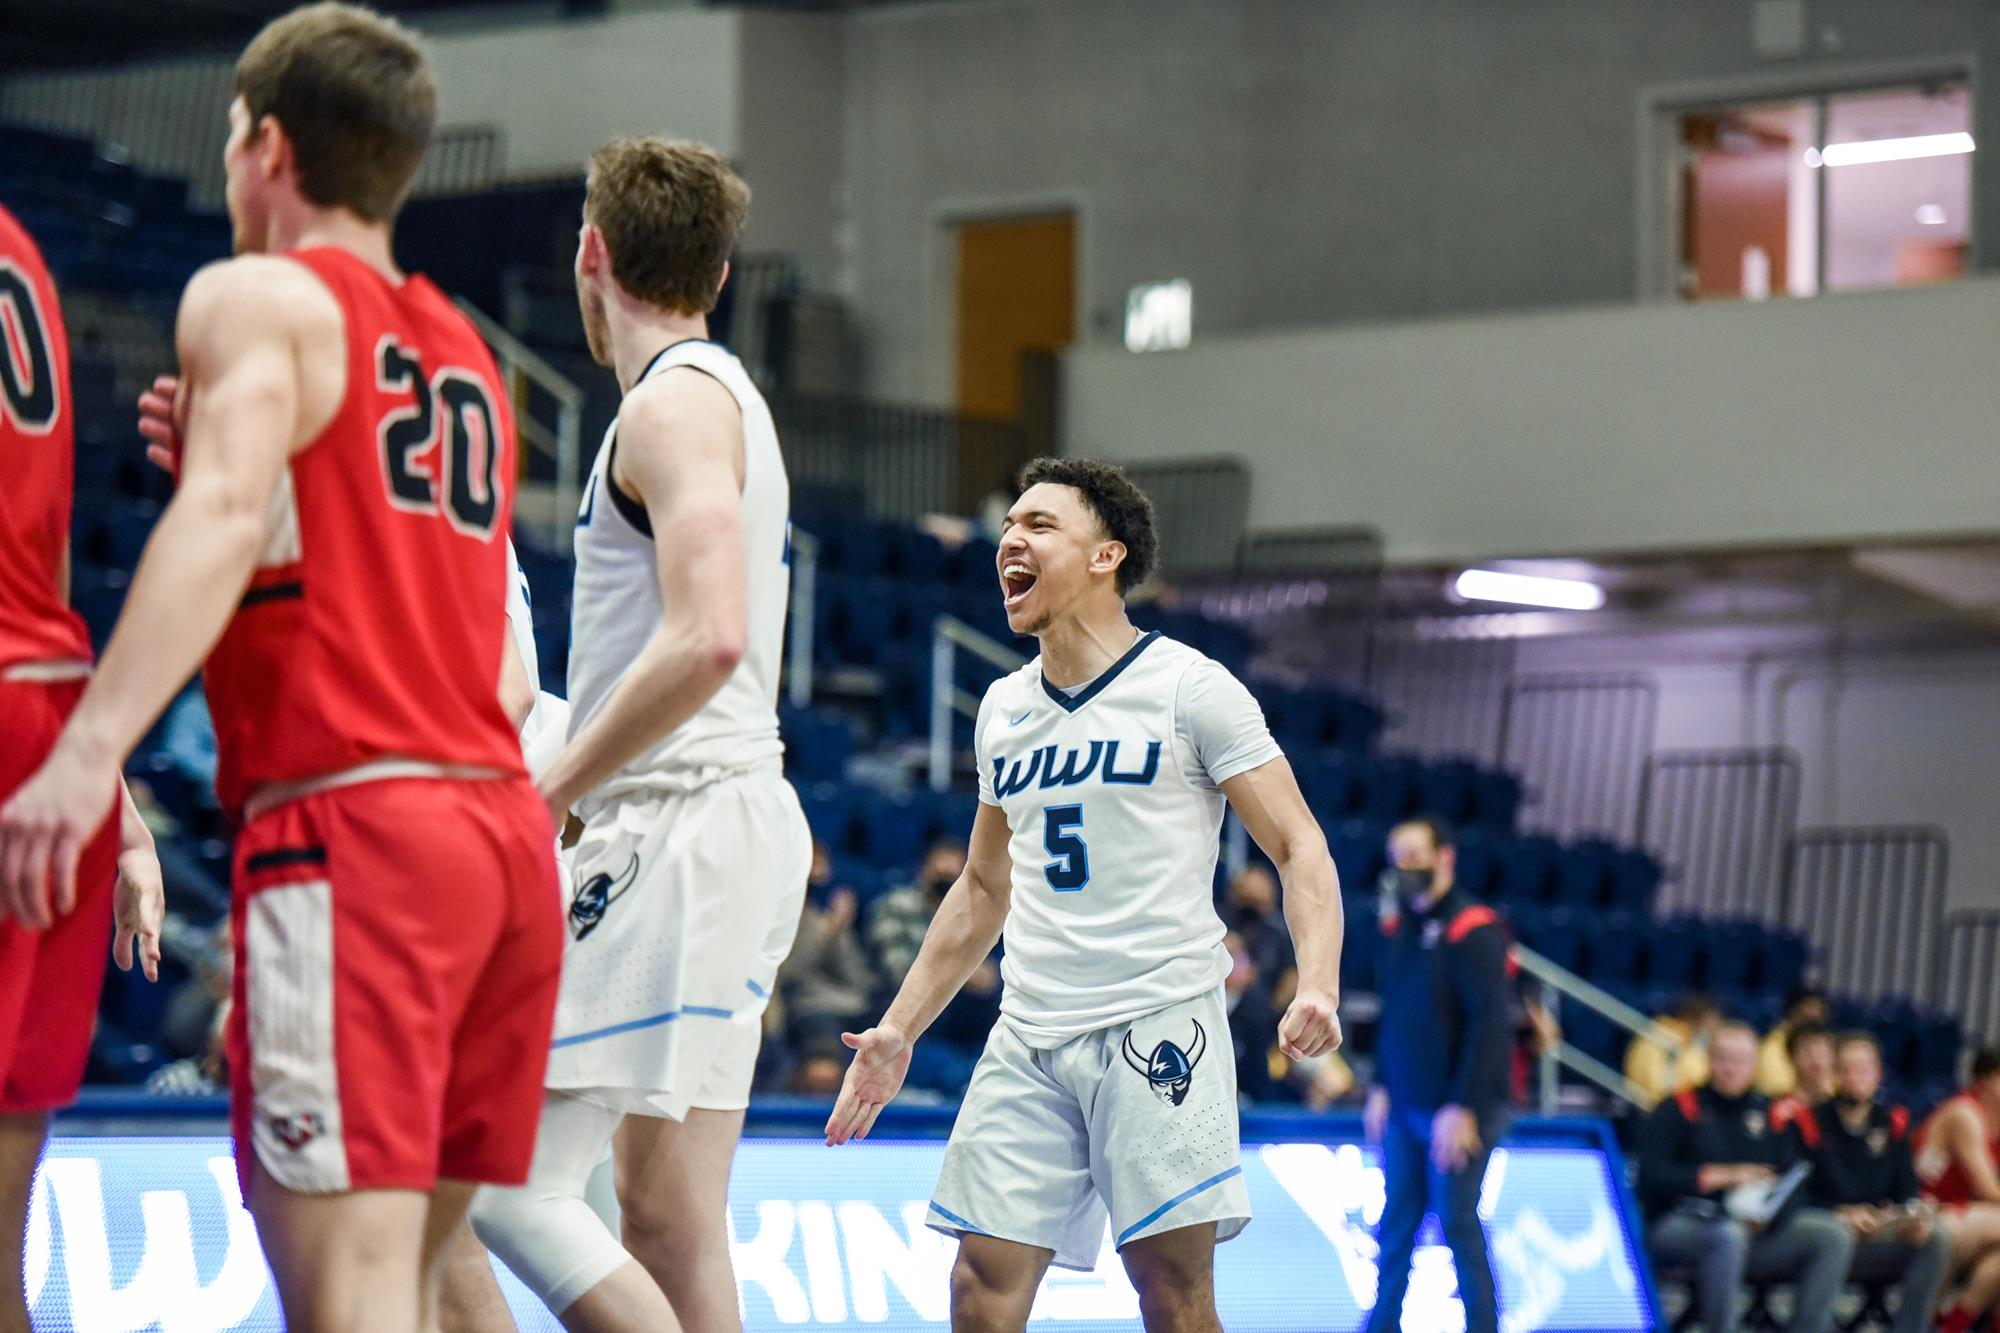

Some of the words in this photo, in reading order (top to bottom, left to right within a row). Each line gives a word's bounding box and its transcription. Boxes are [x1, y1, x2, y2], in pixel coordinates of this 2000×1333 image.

[374, 332, 506, 544] 20
[991, 738, 1164, 801] WWU
[1042, 803, 1091, 893] 5
